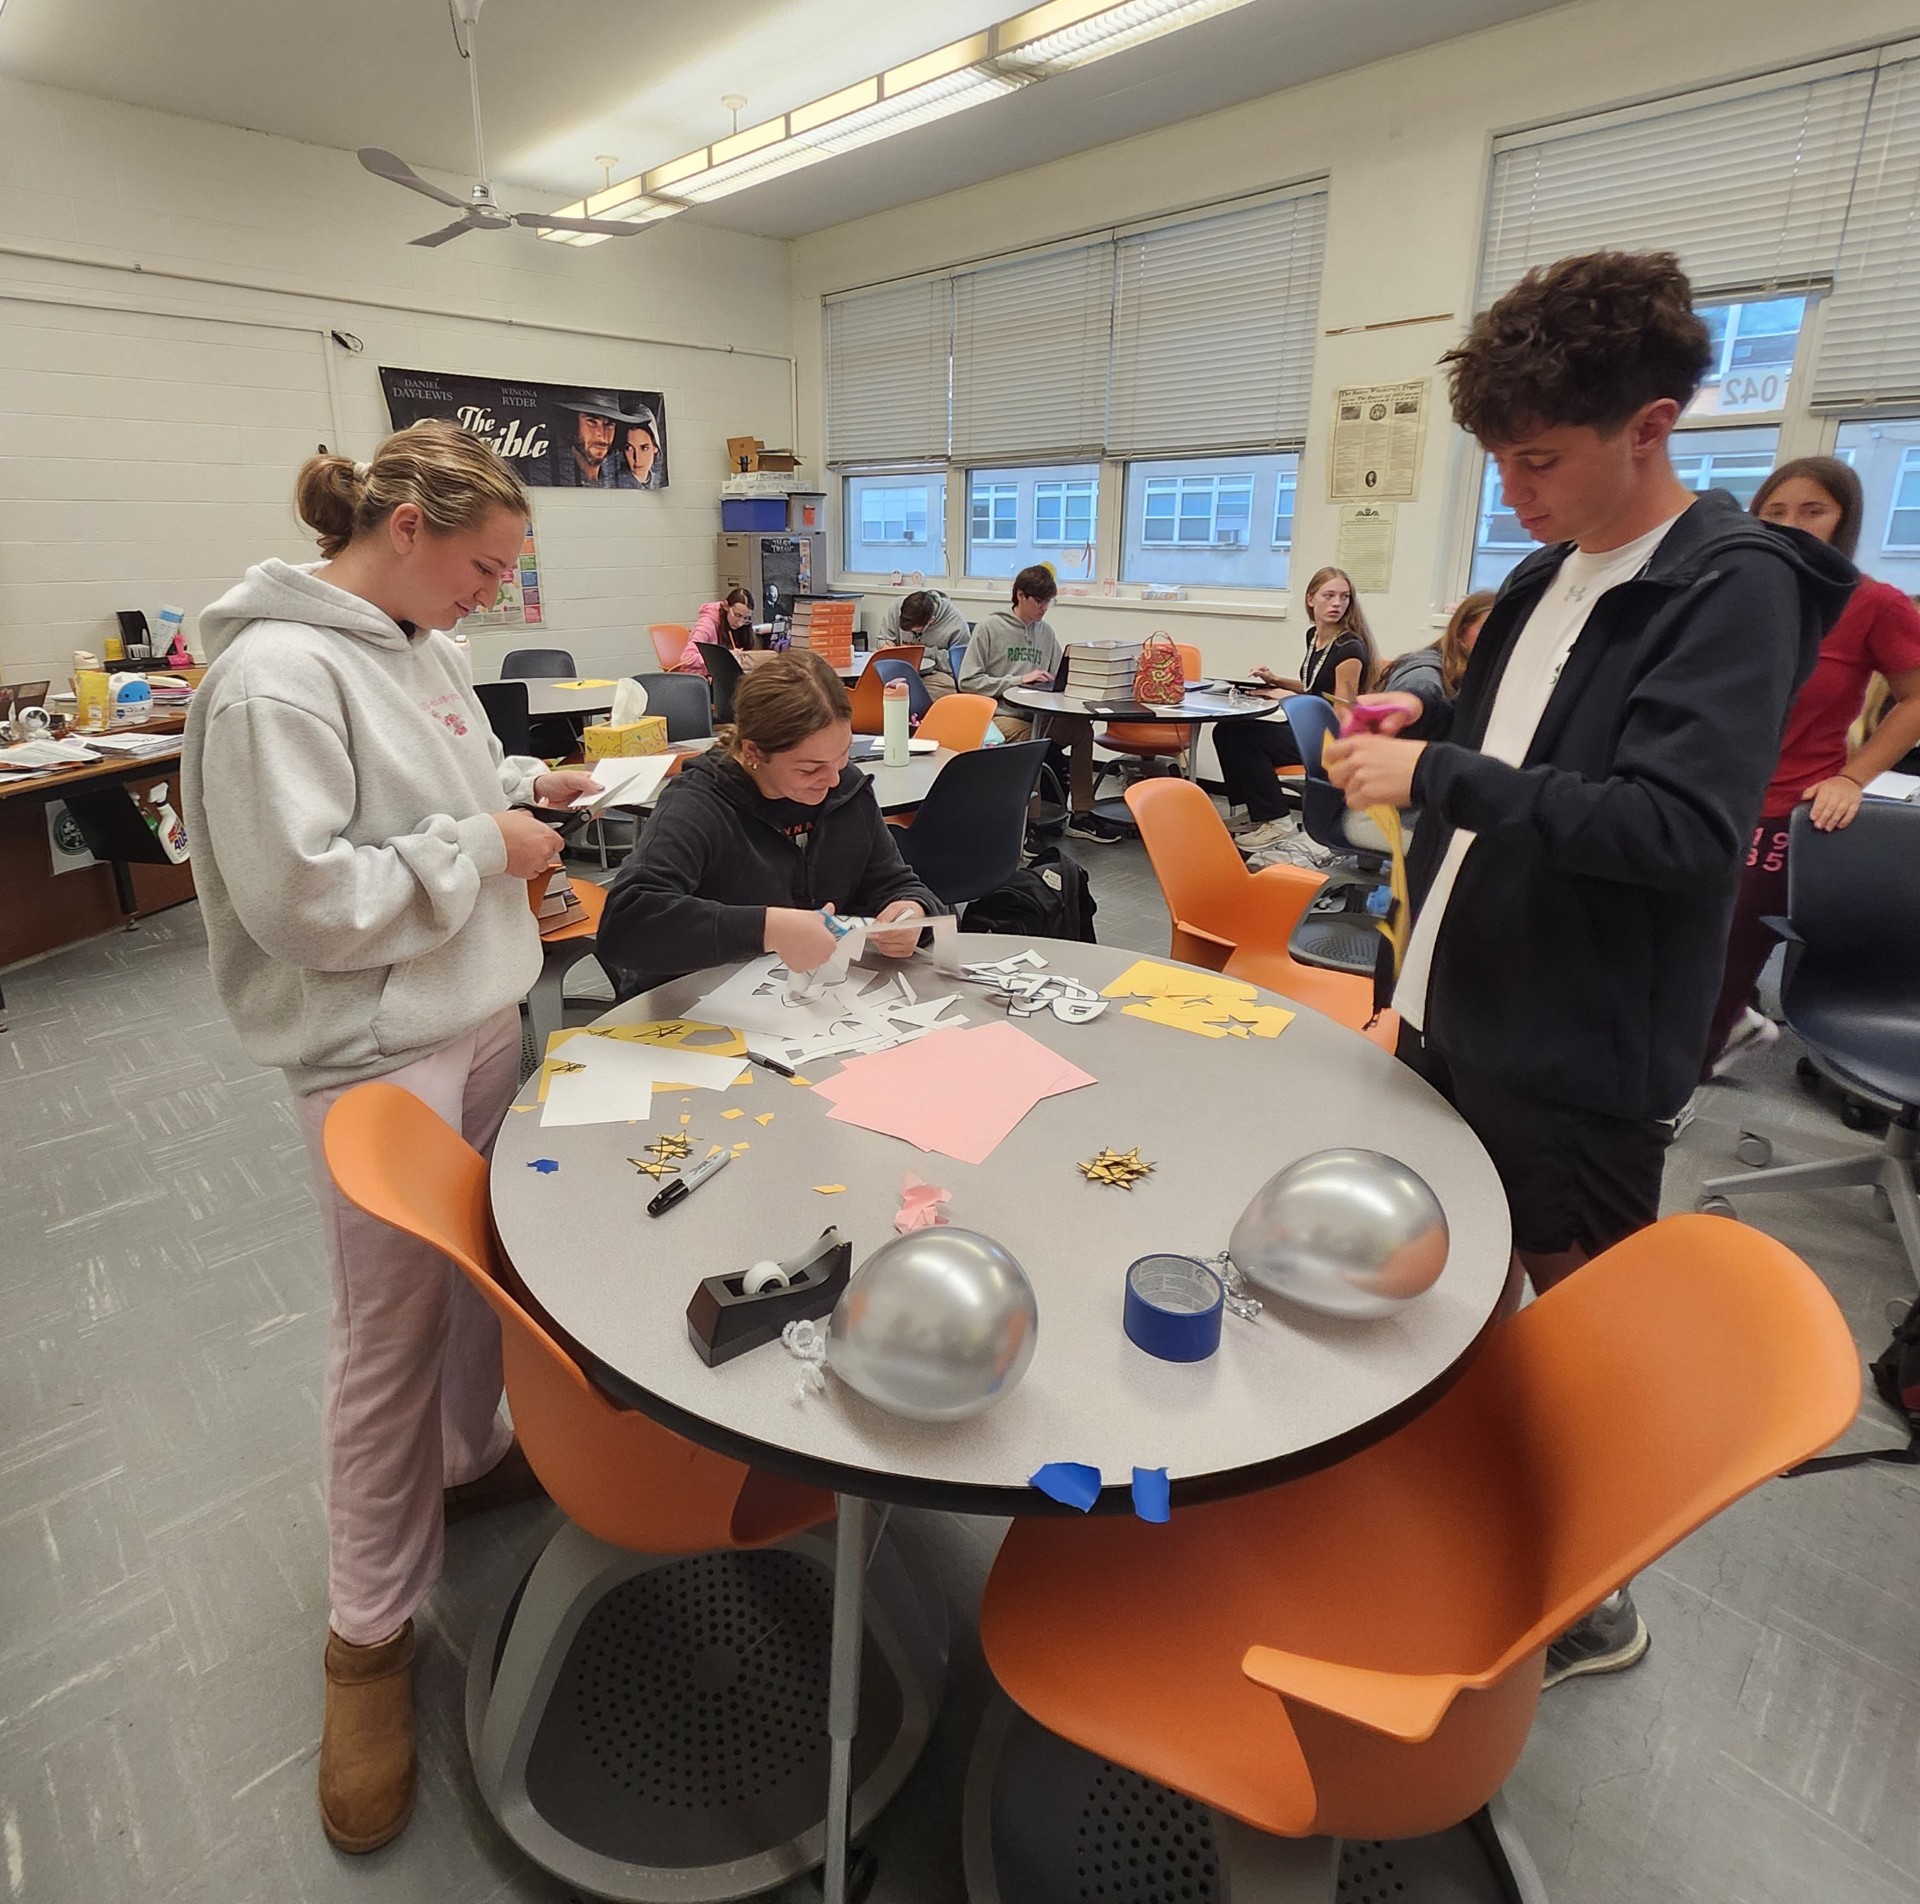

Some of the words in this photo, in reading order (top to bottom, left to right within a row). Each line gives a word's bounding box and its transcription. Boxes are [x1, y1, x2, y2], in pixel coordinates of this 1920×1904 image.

[404, 378, 441, 389] DANIEL
[501, 387, 538, 398] WINONA
[501, 396, 537, 408] RYDER
[456, 405, 496, 434] The
